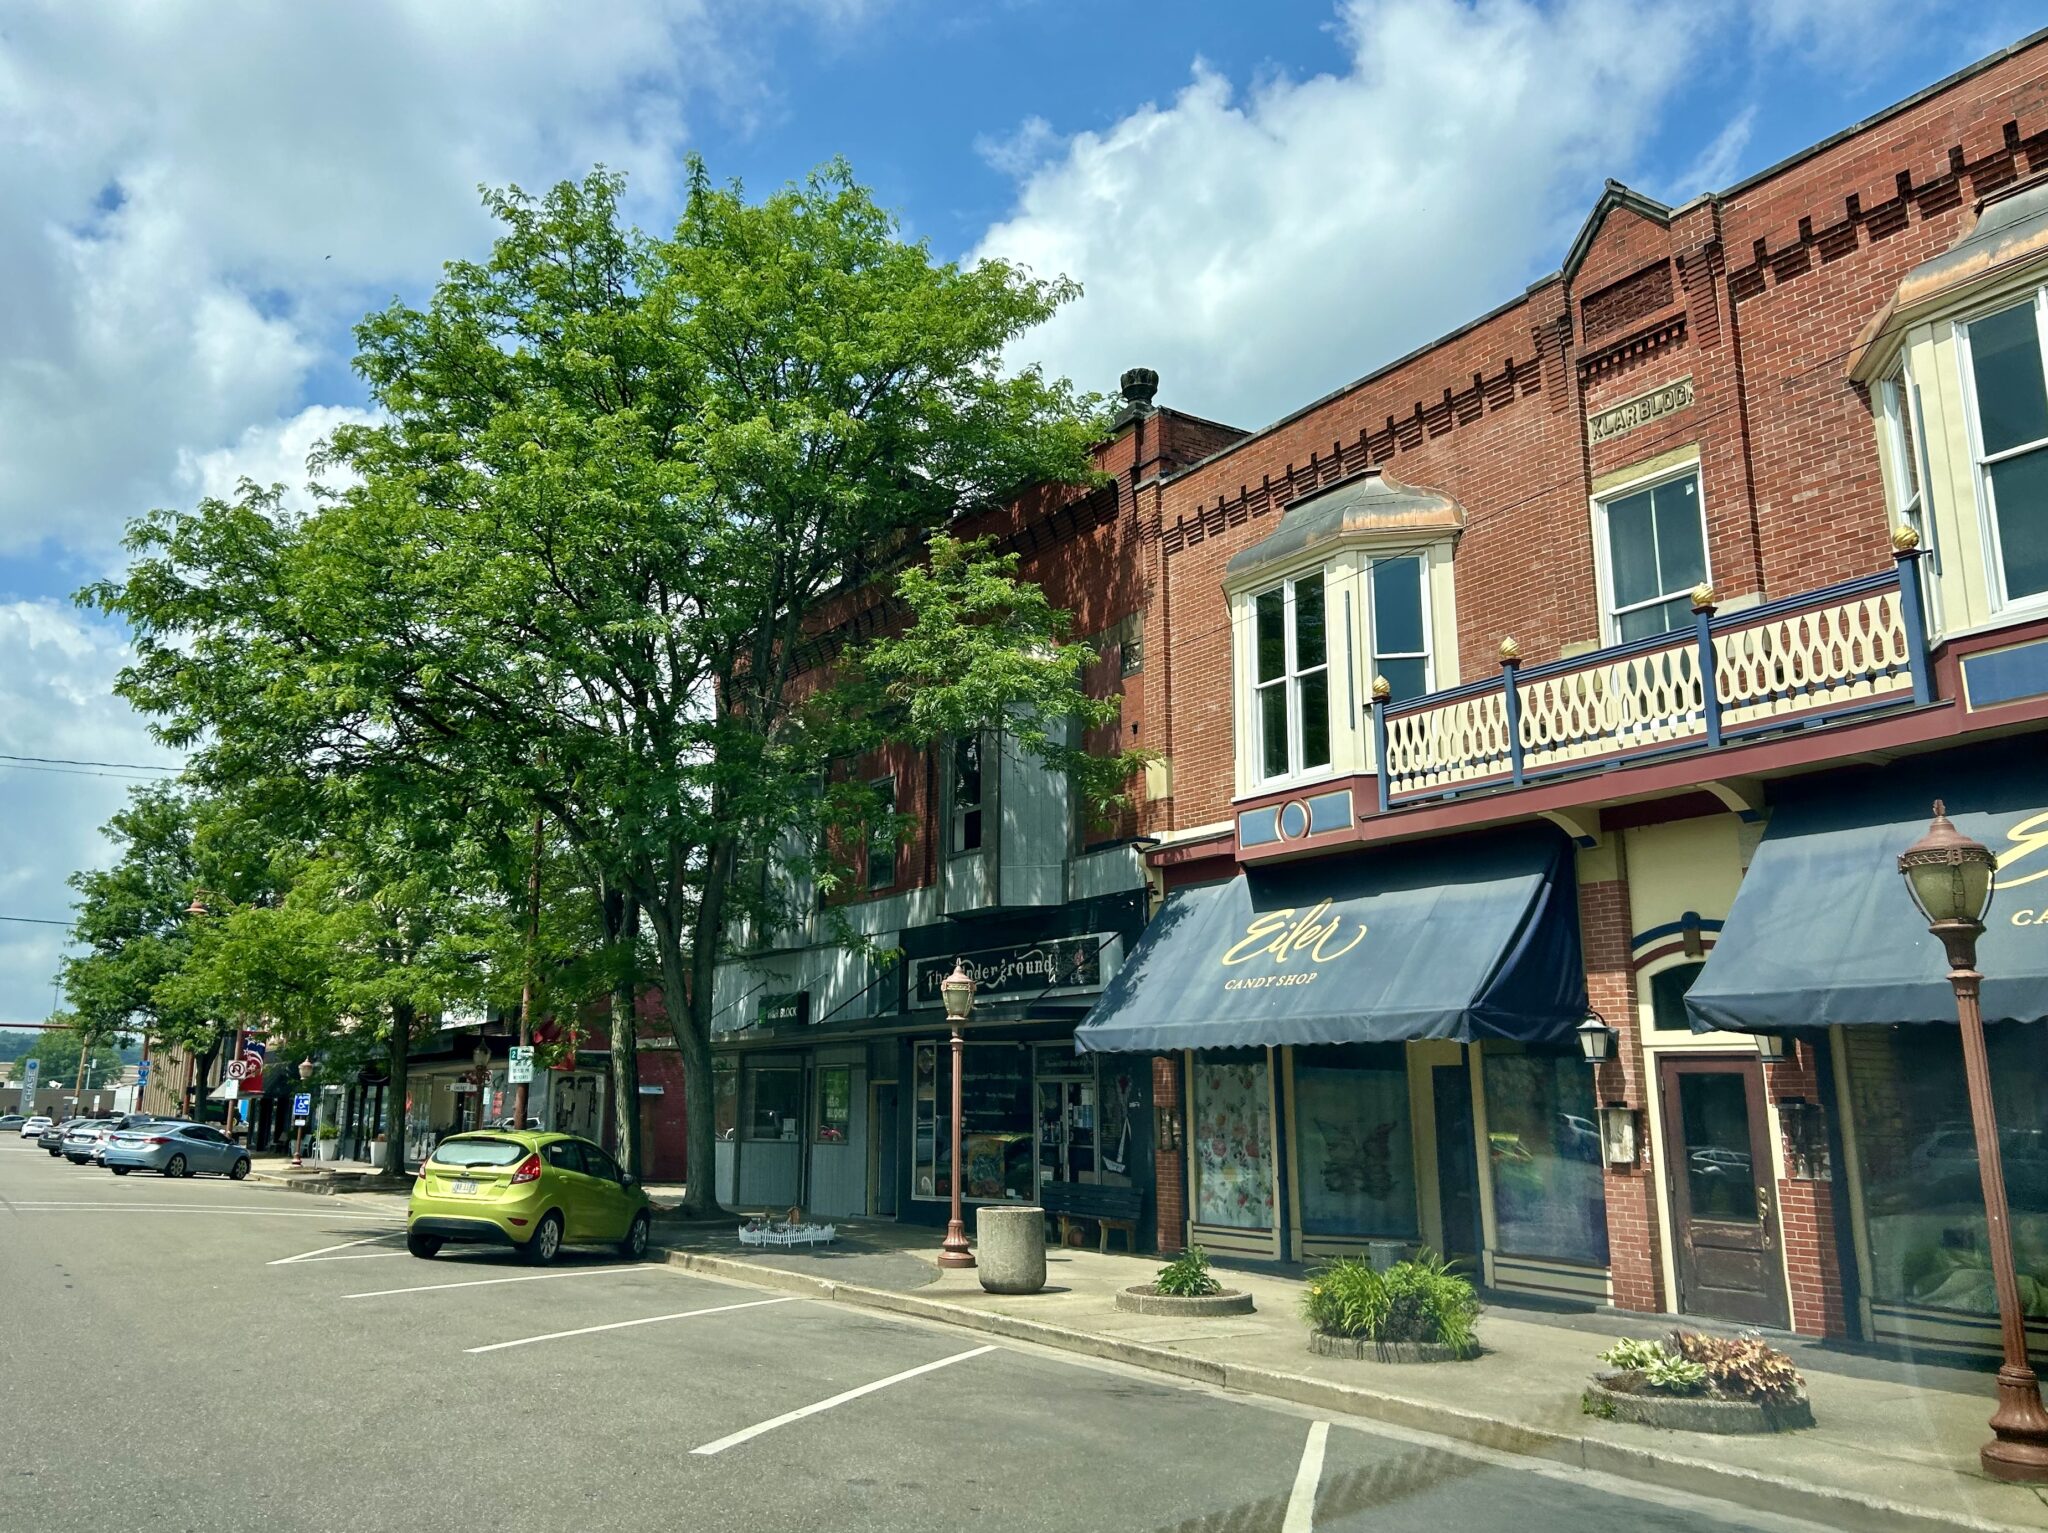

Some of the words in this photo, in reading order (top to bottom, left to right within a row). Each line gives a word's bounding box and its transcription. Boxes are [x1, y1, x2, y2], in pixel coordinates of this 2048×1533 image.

[1222, 897, 1367, 966] Eiler
[1224, 975, 1276, 990] CANDY
[1276, 972, 1318, 988] SHOP
[780, 1006, 797, 1018] BLOCK
[24, 1070, 36, 1101] CHASE
